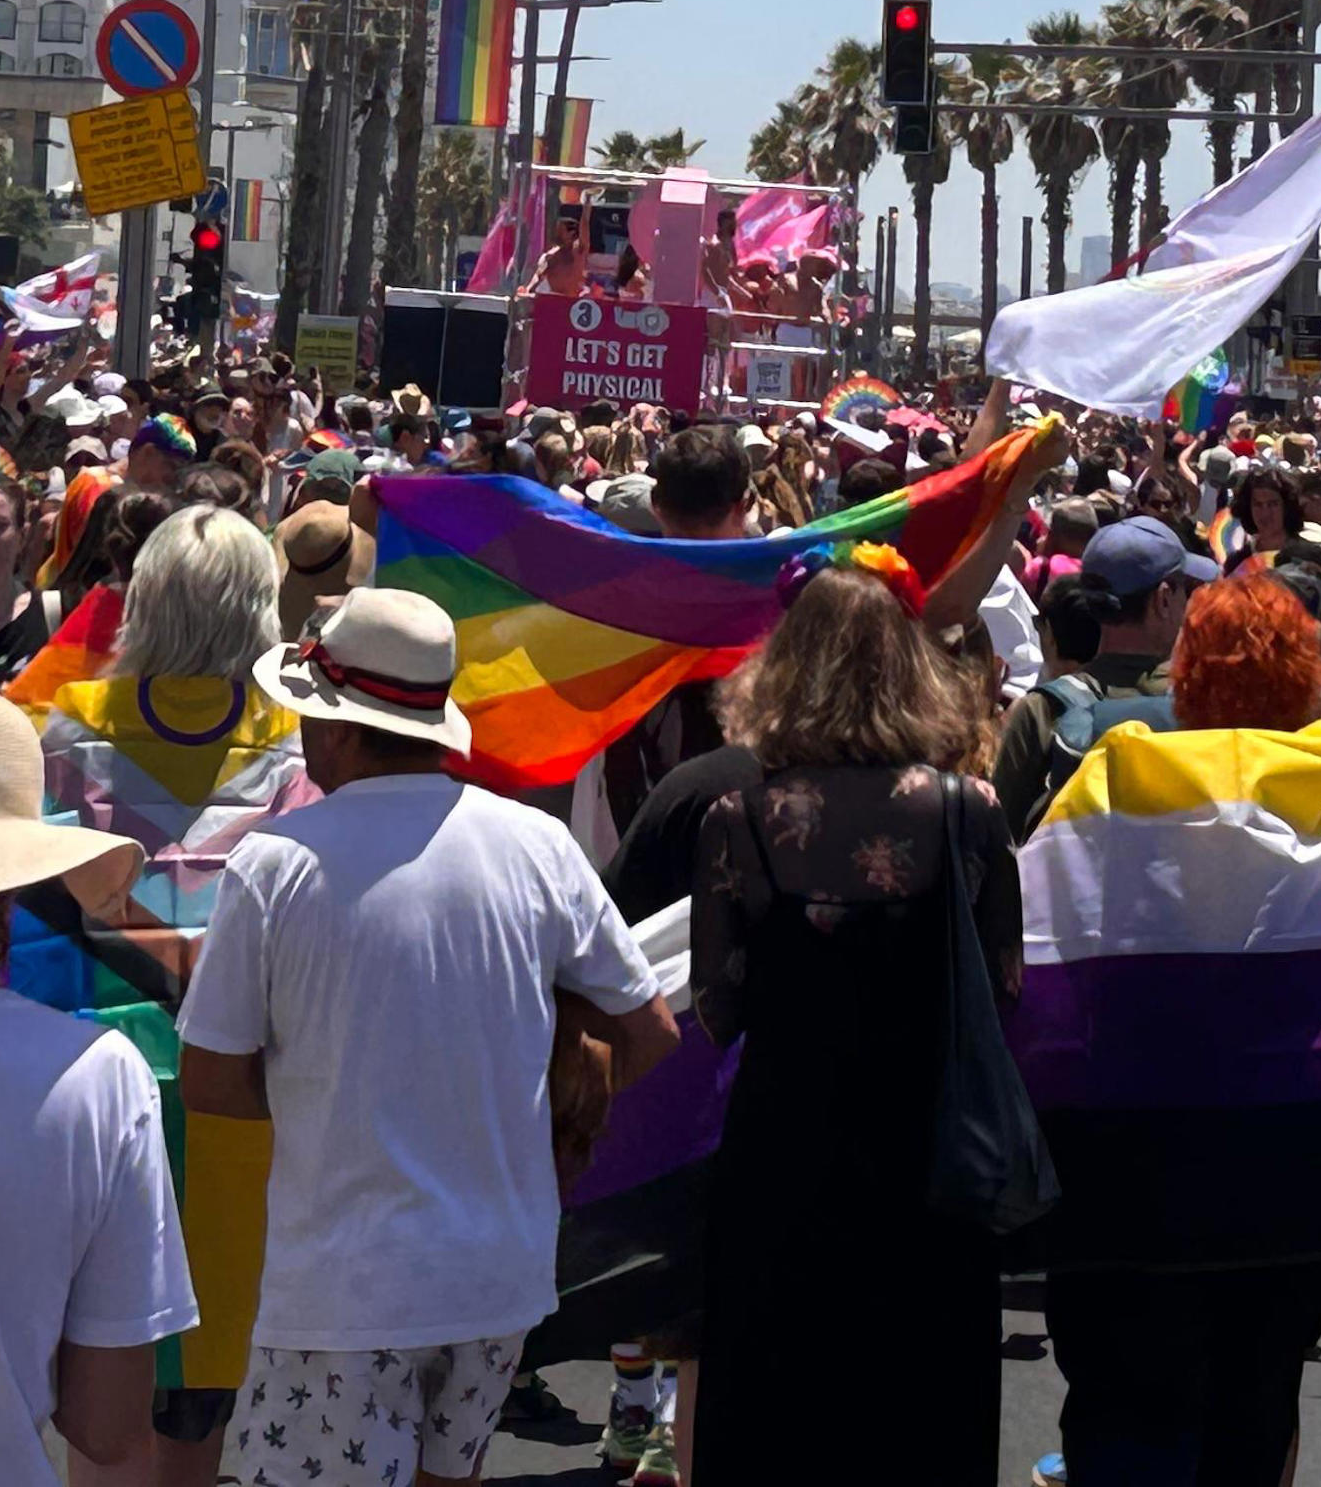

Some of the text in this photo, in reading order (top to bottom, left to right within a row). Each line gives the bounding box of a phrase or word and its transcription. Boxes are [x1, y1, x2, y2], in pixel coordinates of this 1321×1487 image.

[565, 337, 668, 369] LET'S GET
[563, 371, 664, 401] PHYSICAL
